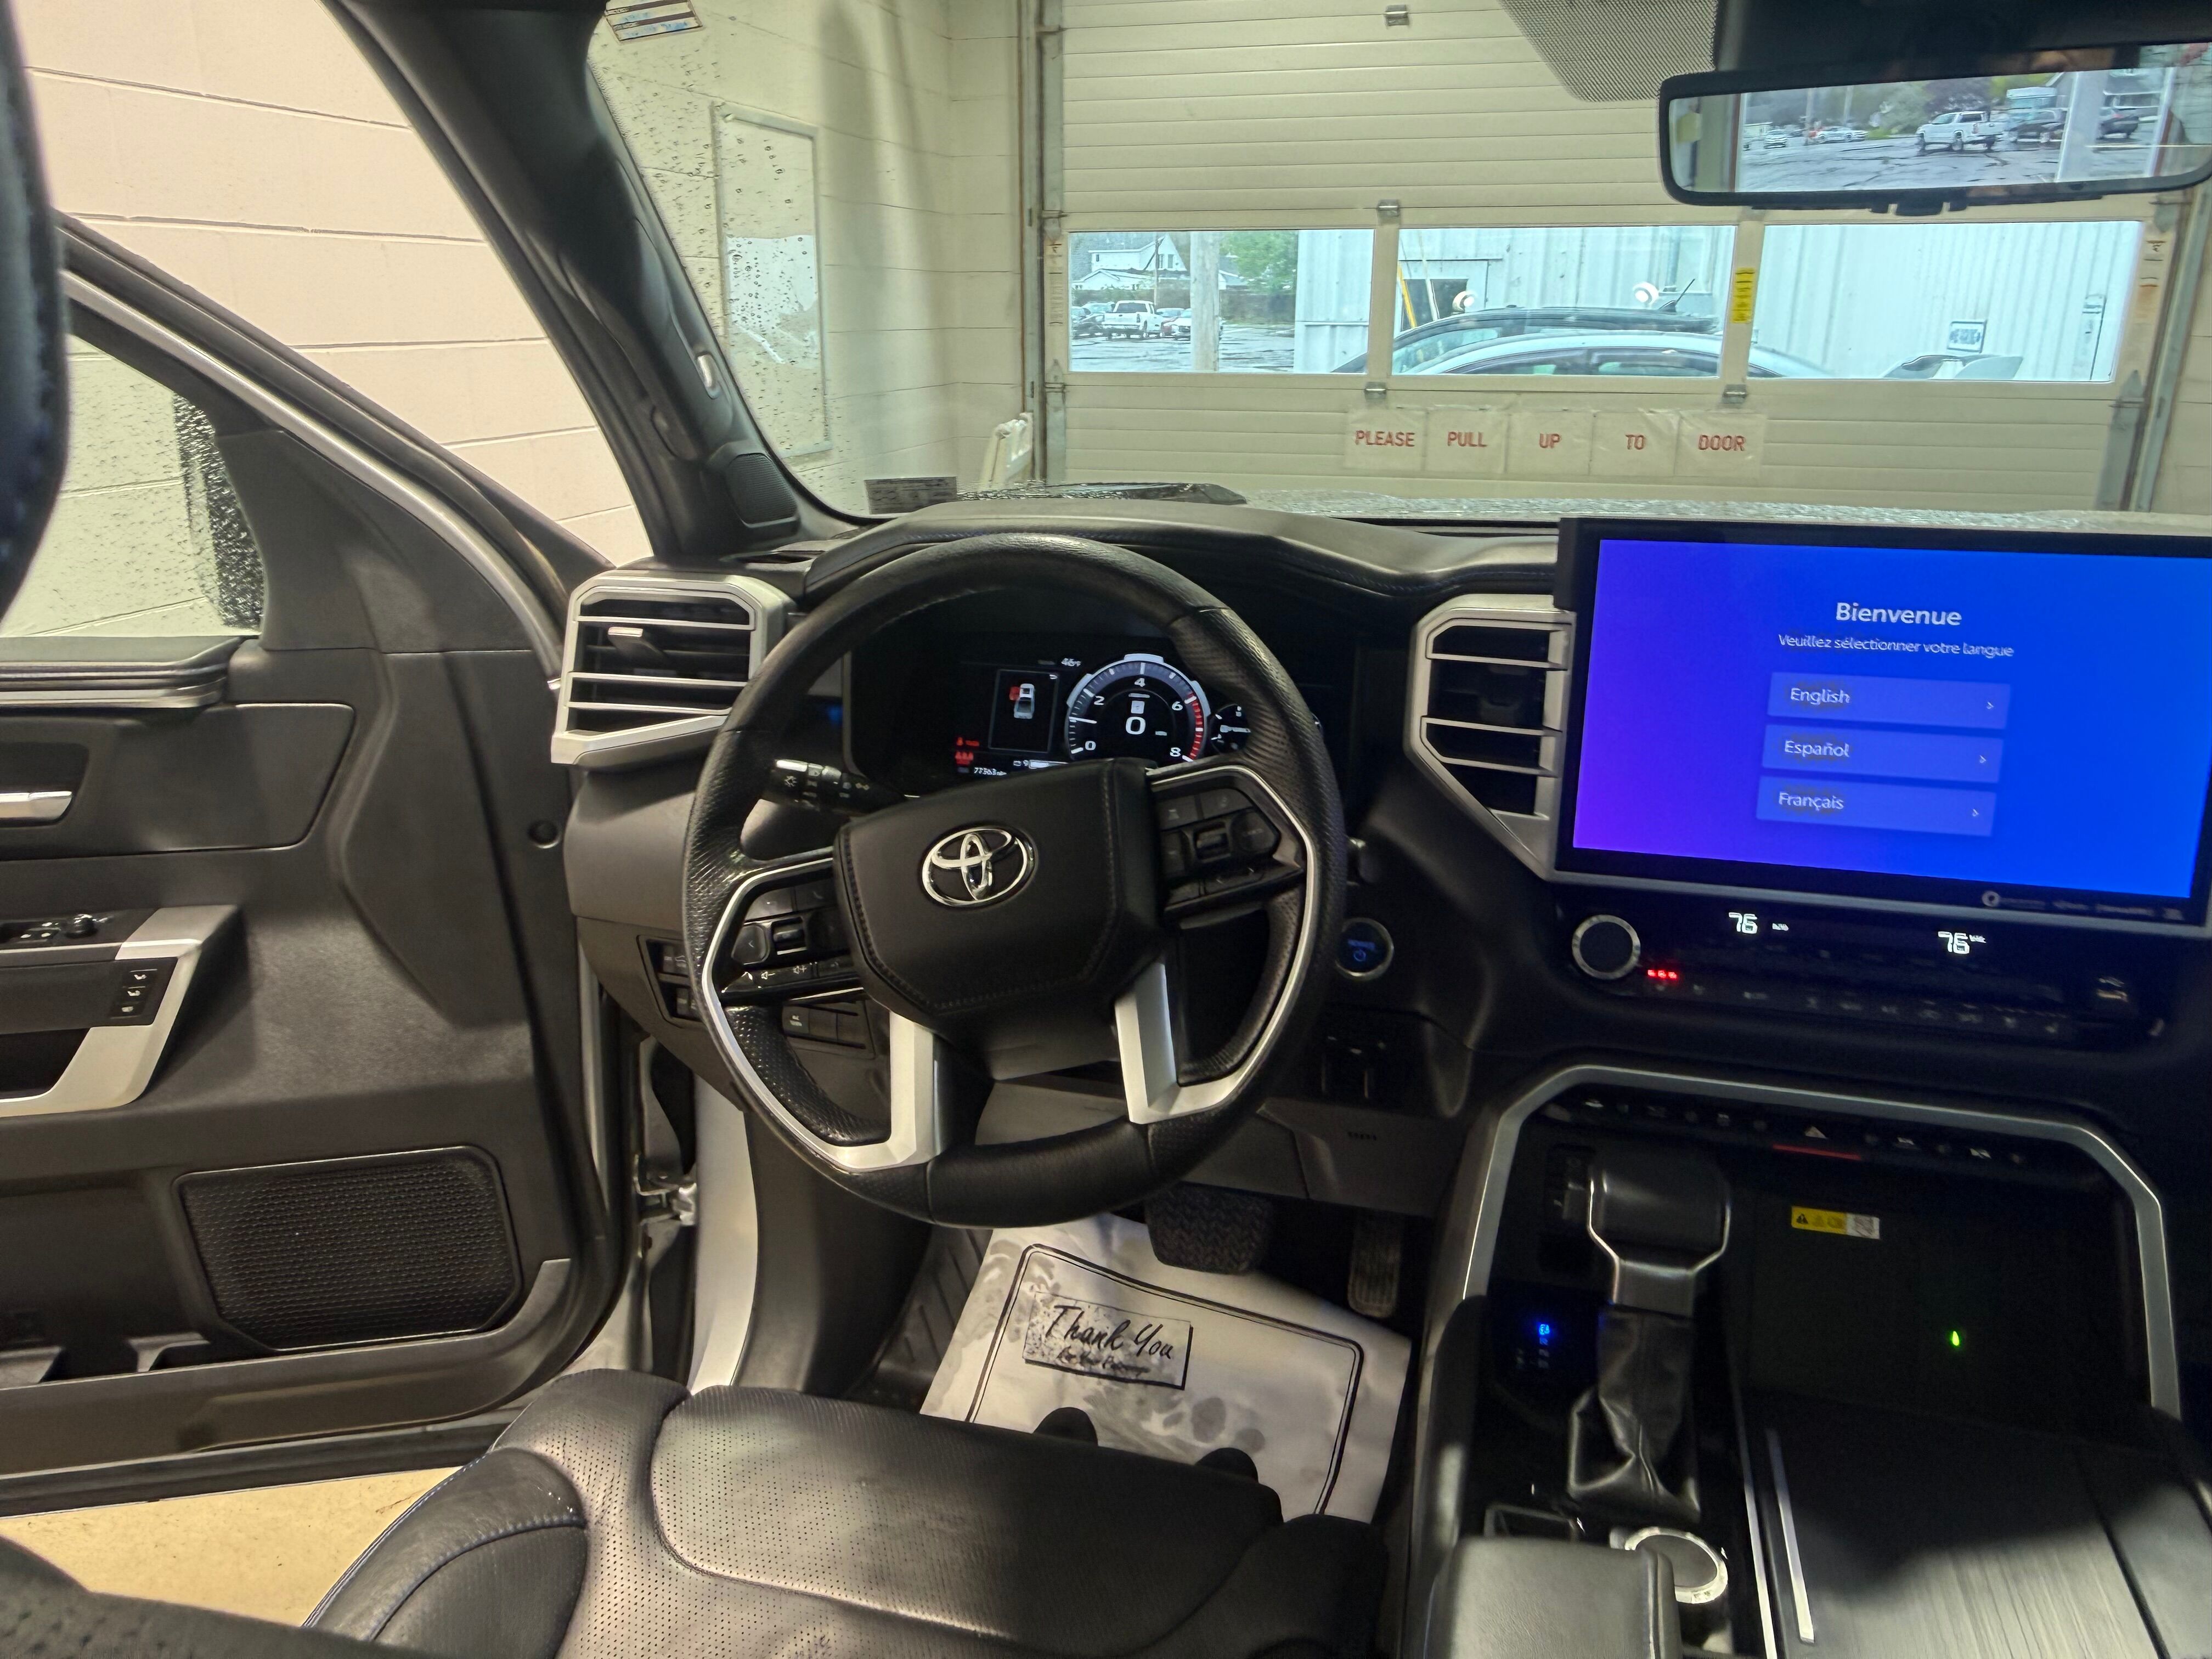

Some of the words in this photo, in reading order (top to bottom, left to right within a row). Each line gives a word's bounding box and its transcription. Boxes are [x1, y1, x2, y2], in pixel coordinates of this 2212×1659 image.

[1355, 430, 1415, 447] PLEASE
[1447, 432, 1487, 448] PULL
[1539, 433, 1561, 449] UP
[1626, 434, 1646, 450] TO
[1698, 435, 1746, 451] DOOR
[1835, 602, 1962, 626] Bienvenue
[1778, 634, 1831, 648] Veuillez
[1834, 635, 1921, 652] sélectionner
[1923, 642, 1960, 654] votre
[1962, 644, 2015, 658] langue
[1134, 678, 1146, 687] 4
[1093, 696, 1105, 706] 2
[1790, 687, 1850, 705] English
[1172, 701, 1183, 711] 6
[1125, 716, 1146, 735] 0
[1085, 741, 1096, 751] 0
[1170, 747, 1181, 757] 8
[1785, 741, 1849, 757] Español
[1779, 792, 1844, 811] Français
[1729, 912, 1758, 934] 76
[1938, 931, 1970, 955] 76
[1045, 1305, 1131, 1350] Thank
[1133, 1323, 1173, 1359] You
